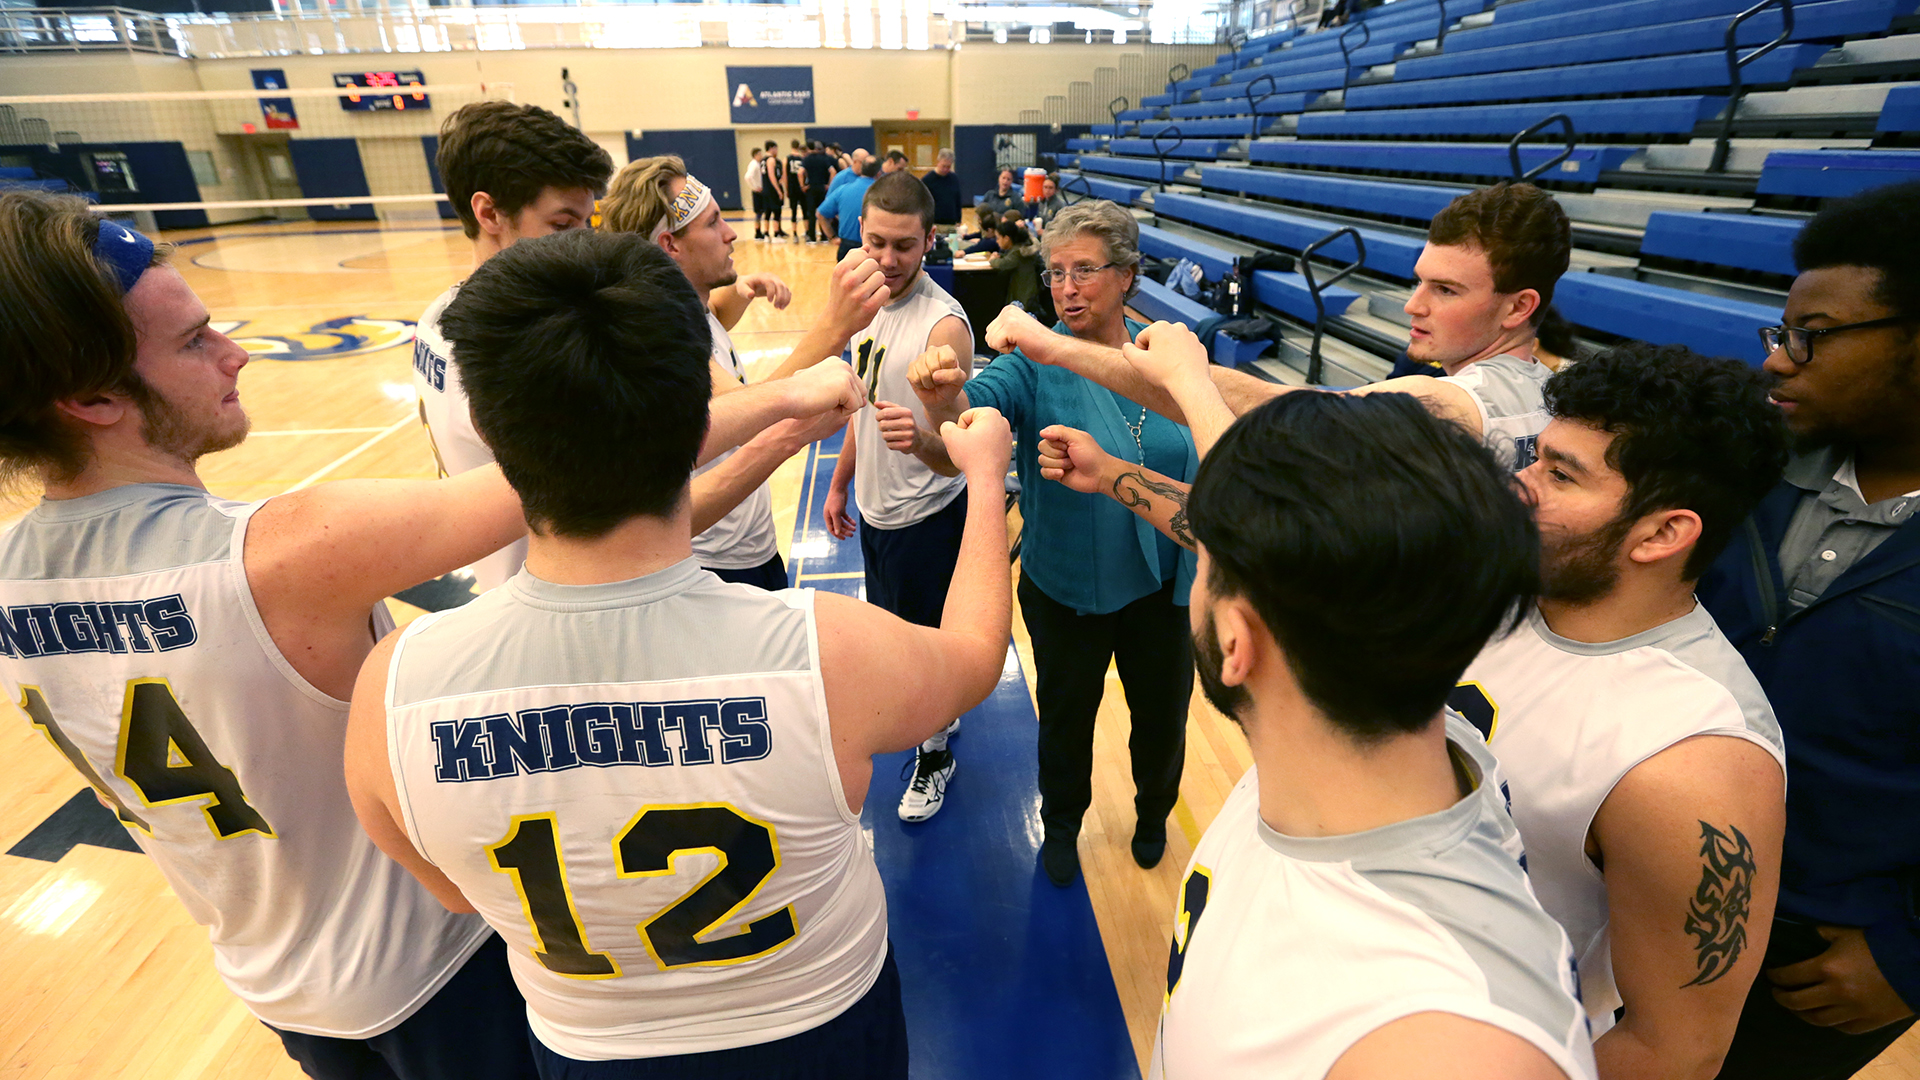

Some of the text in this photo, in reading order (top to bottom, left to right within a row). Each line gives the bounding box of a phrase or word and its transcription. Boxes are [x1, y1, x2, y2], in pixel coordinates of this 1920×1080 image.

[760, 90, 811, 99] ATLANTIC EAST
[671, 173, 704, 223] KNI
[0, 593, 198, 659] NIGHTS
[18, 676, 279, 841] 14
[430, 697, 773, 783] KNIGHTS
[483, 802, 799, 980] 12
